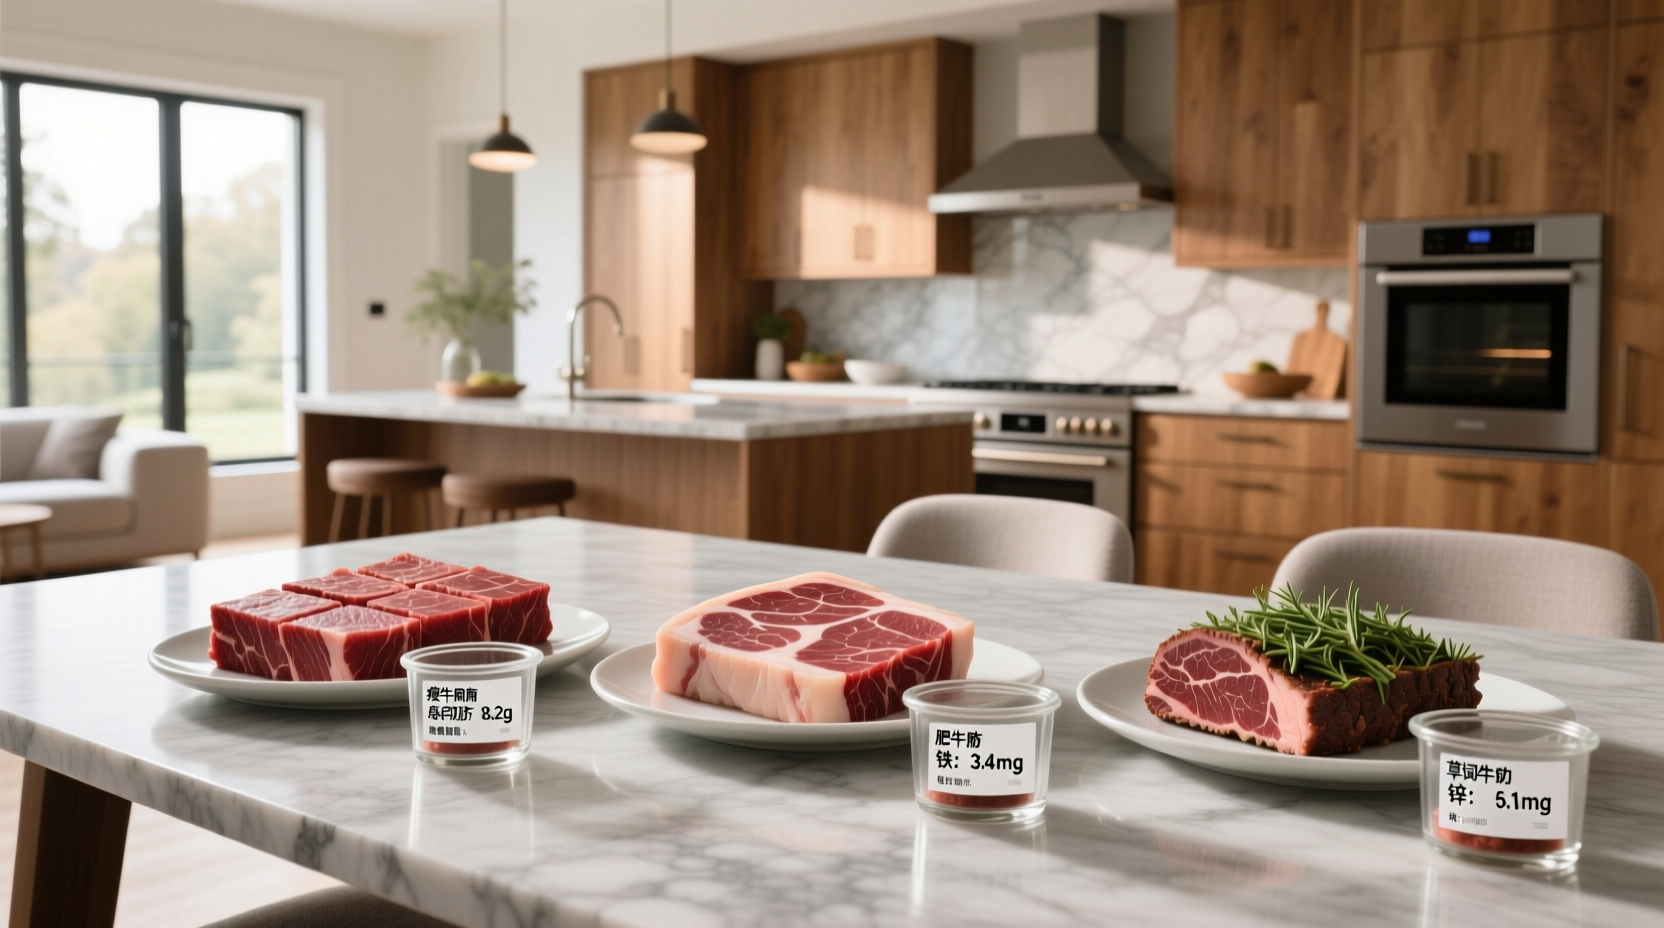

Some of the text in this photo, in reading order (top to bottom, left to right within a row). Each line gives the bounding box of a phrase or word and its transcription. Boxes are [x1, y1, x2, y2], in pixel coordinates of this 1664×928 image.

[481, 705, 512, 724] 8.2g
[970, 753, 1023, 775] 3.4mg
[1495, 790, 1552, 816] 5.1mg
